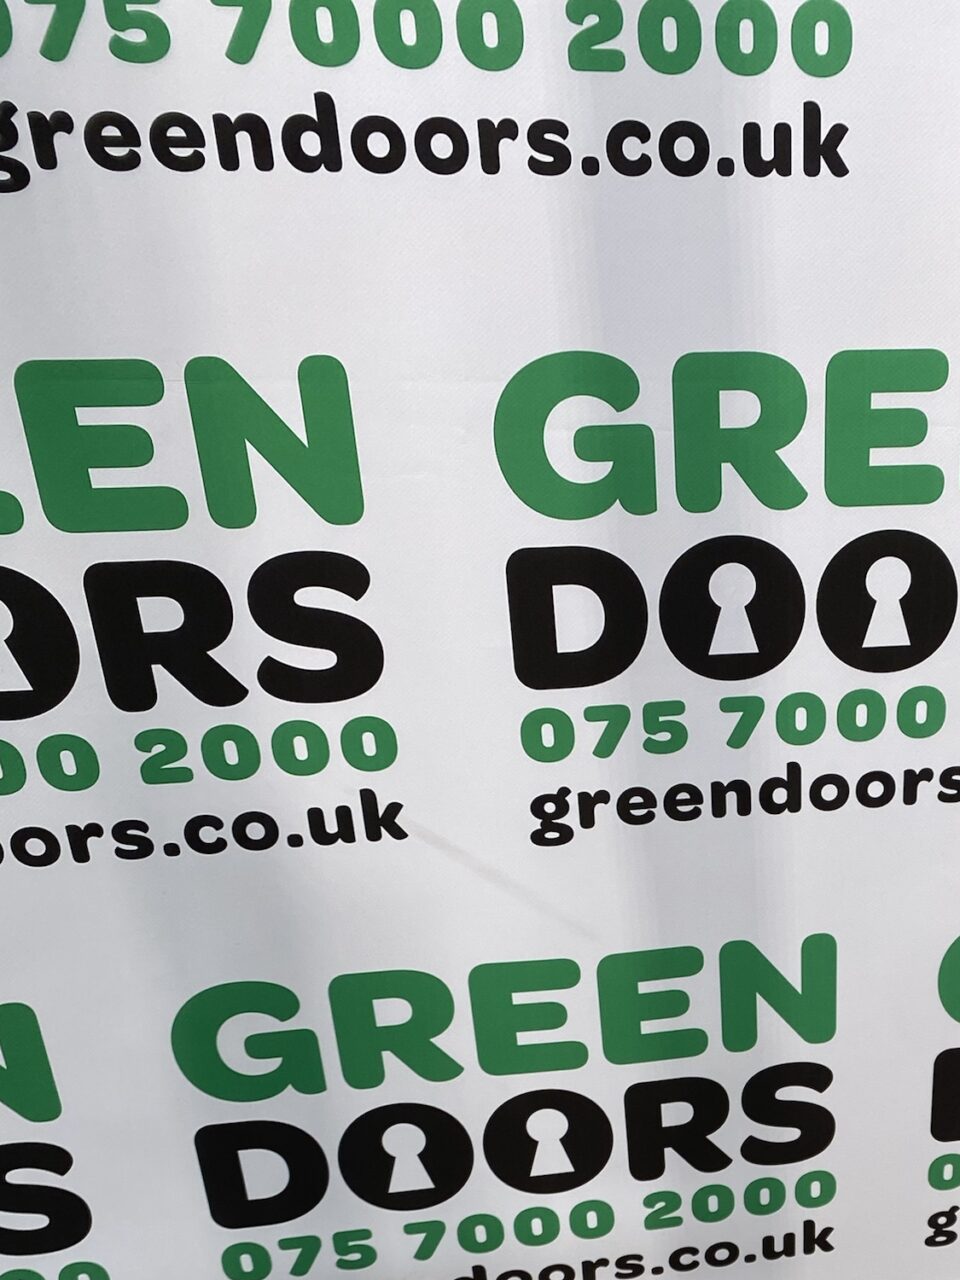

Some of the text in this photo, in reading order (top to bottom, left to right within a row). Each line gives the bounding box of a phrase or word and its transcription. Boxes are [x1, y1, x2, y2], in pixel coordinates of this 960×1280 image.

[0, 0, 854, 79] 75 7000 2000
[0, 354, 365, 535] EN
[134, 715, 399, 786] 2000
[520, 699, 690, 764] 075
[719, 685, 947, 750] 7000
[0, 788, 410, 869] ors.co.uk
[170, 931, 838, 1103] GREEN
[193, 1060, 837, 1230] DOORS
[403, 1199, 616, 1260] 7000
[642, 1169, 837, 1231] 2000
